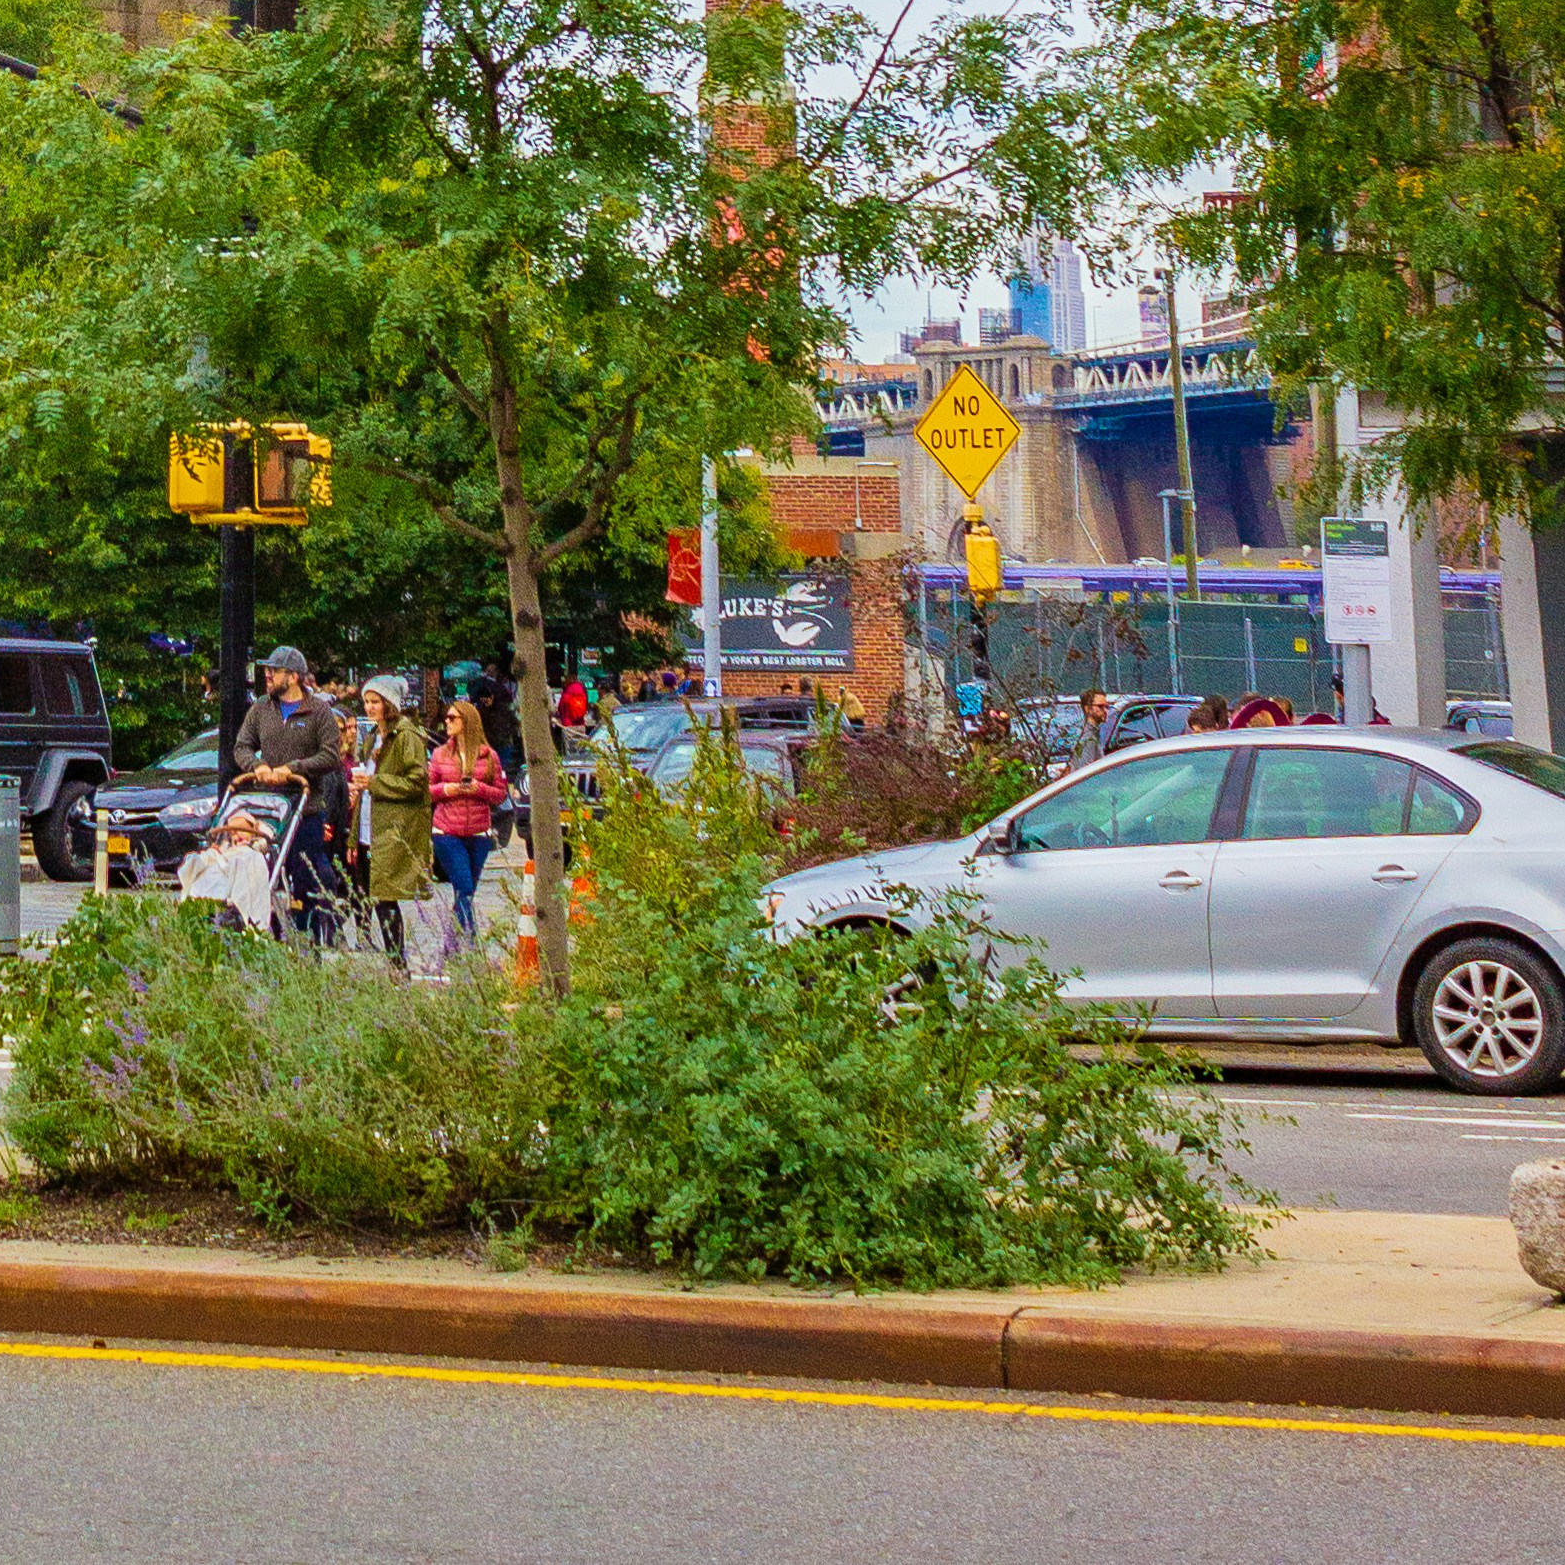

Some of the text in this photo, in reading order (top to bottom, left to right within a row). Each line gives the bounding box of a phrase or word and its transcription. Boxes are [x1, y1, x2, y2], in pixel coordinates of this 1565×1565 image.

[953, 396, 980, 416] NO
[931, 428, 1005, 449] OUTLET
[762, 656, 784, 666] BEST
[786, 656, 824, 667] LOBSTER
[825, 656, 846, 667] ROLL
